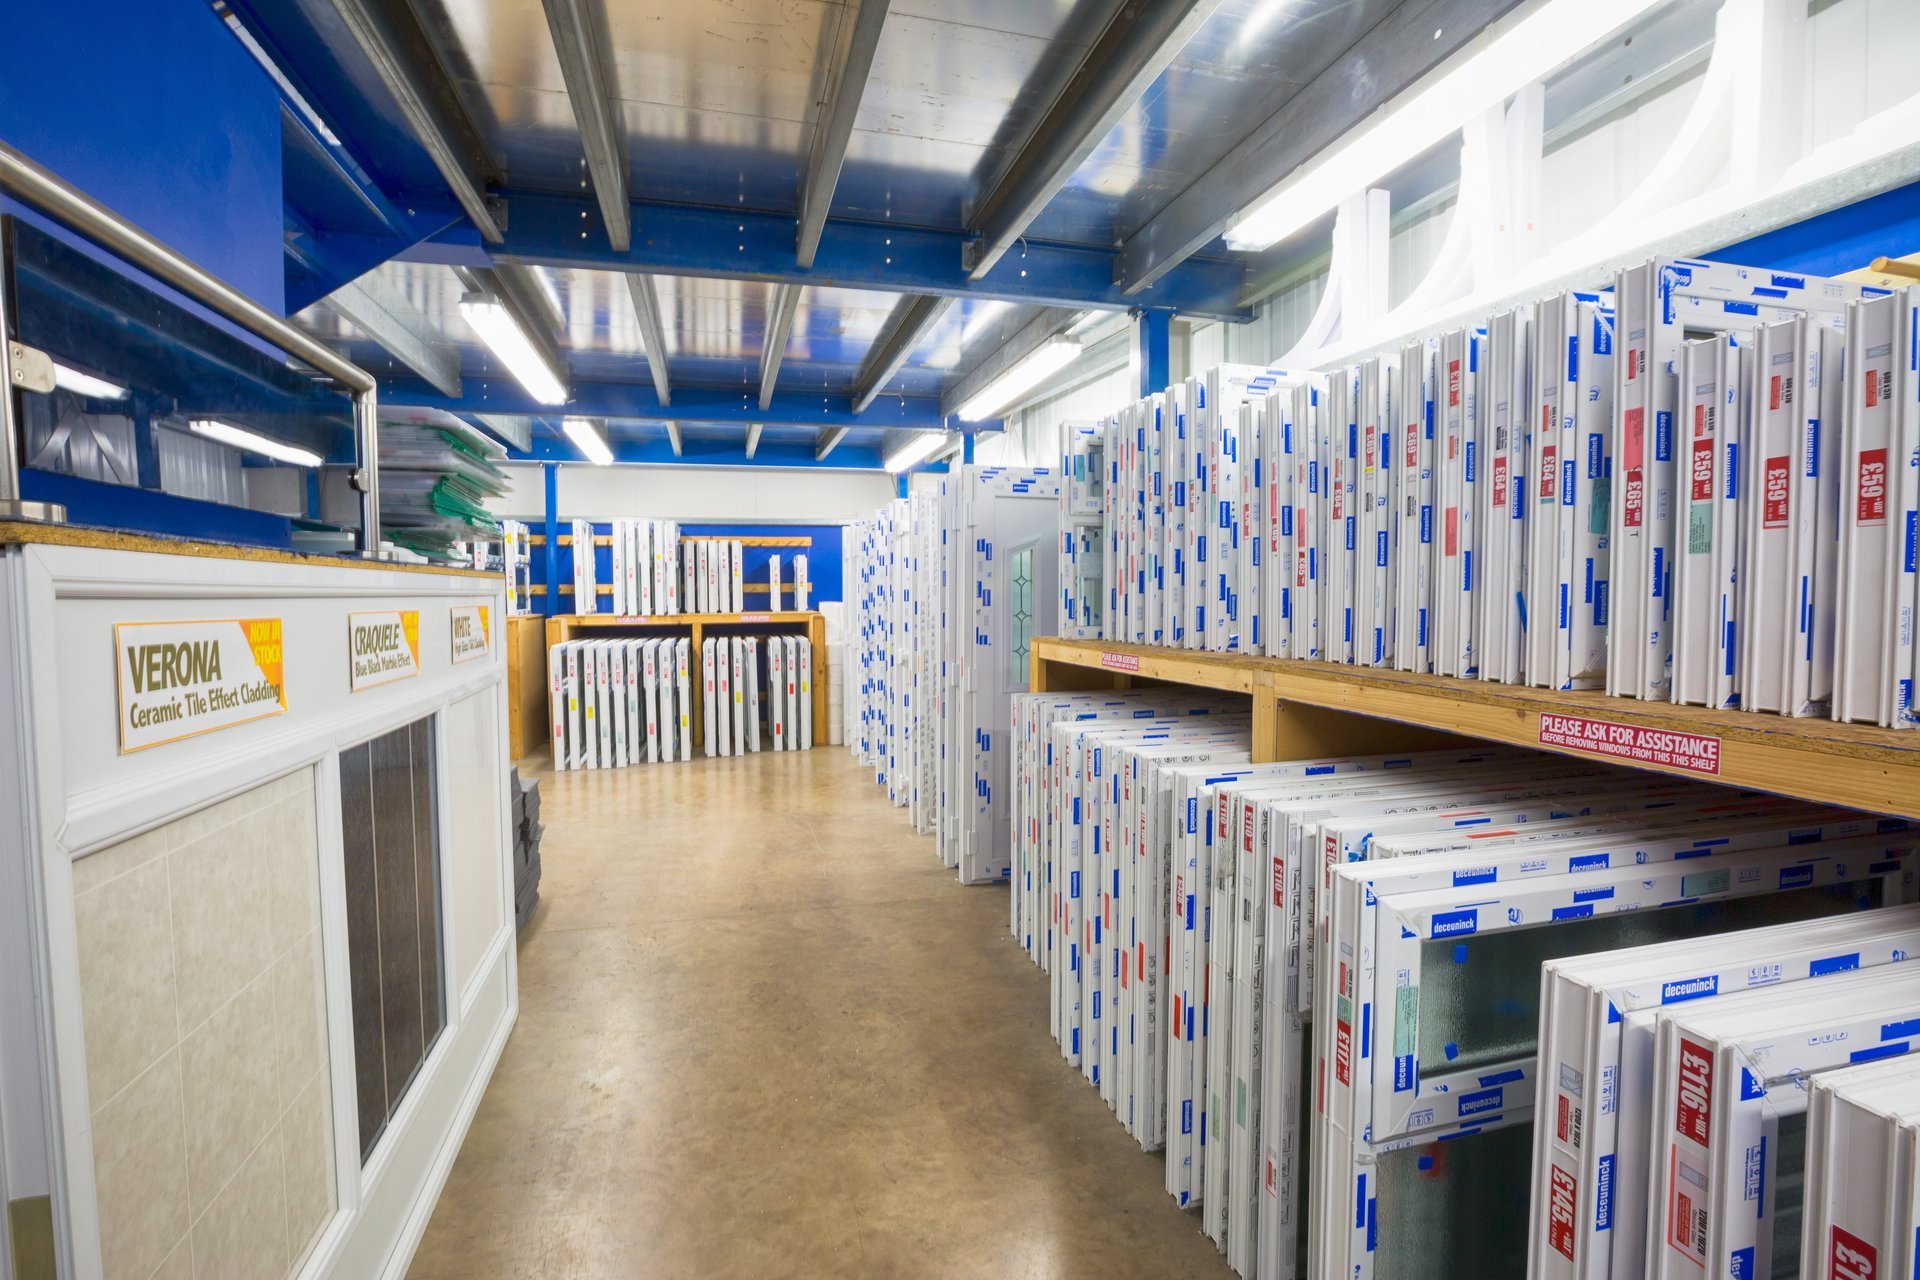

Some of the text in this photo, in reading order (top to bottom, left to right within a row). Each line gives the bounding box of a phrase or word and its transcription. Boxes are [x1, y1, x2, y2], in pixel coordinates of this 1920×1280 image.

[1449, 371, 1459, 392] £70
[1407, 432, 1416, 453] £69
[1659, 414, 1668, 457] deceuninck
[1542, 456, 1555, 481] £64
[1589, 436, 1598, 477] deceuninck
[1694, 450, 1712, 481] £59
[1495, 466, 1506, 490] £64
[1564, 463, 1572, 503] deceuninck
[1768, 469, 1787, 515] £59 +VAT
[1861, 462, 1884, 513] £59 +VAT
[1627, 481, 1642, 509] £65
[250, 622, 280, 642] NOW IN
[354, 623, 400, 659] CRAQUELE
[454, 616, 471, 639] WHITE
[127, 640, 222, 694] VERONA
[254, 645, 281, 666] STOCK
[355, 653, 410, 678] Blue Black Marble Effect
[130, 680, 281, 729] Ceramic Tile Effect Cladding
[1541, 716, 1717, 759] PLEASE ASK FOR ASSISTANCE
[1542, 732, 1716, 771] BEFORE REMOVING WINDOWS FROM THIS THIS SHELF
[1219, 799, 1227, 824] £110
[1245, 811, 1253, 837] £110
[1274, 863, 1283, 892] £110
[1433, 917, 1474, 934] deceuninck
[1665, 977, 1715, 998] deceuninck
[1337, 1030, 1350, 1066] £117
[1397, 1056, 1407, 1088] deceun
[1461, 1095, 1500, 1113] deceuninck
[1681, 1050, 1710, 1138] £116 +VAT
[1679, 1111, 1687, 1134] 139.20
[1597, 1160, 1610, 1226] deceuninck
[1563, 1231, 1572, 1254] +VAT
[1697, 1209, 1707, 1257] 1200 x 1020
